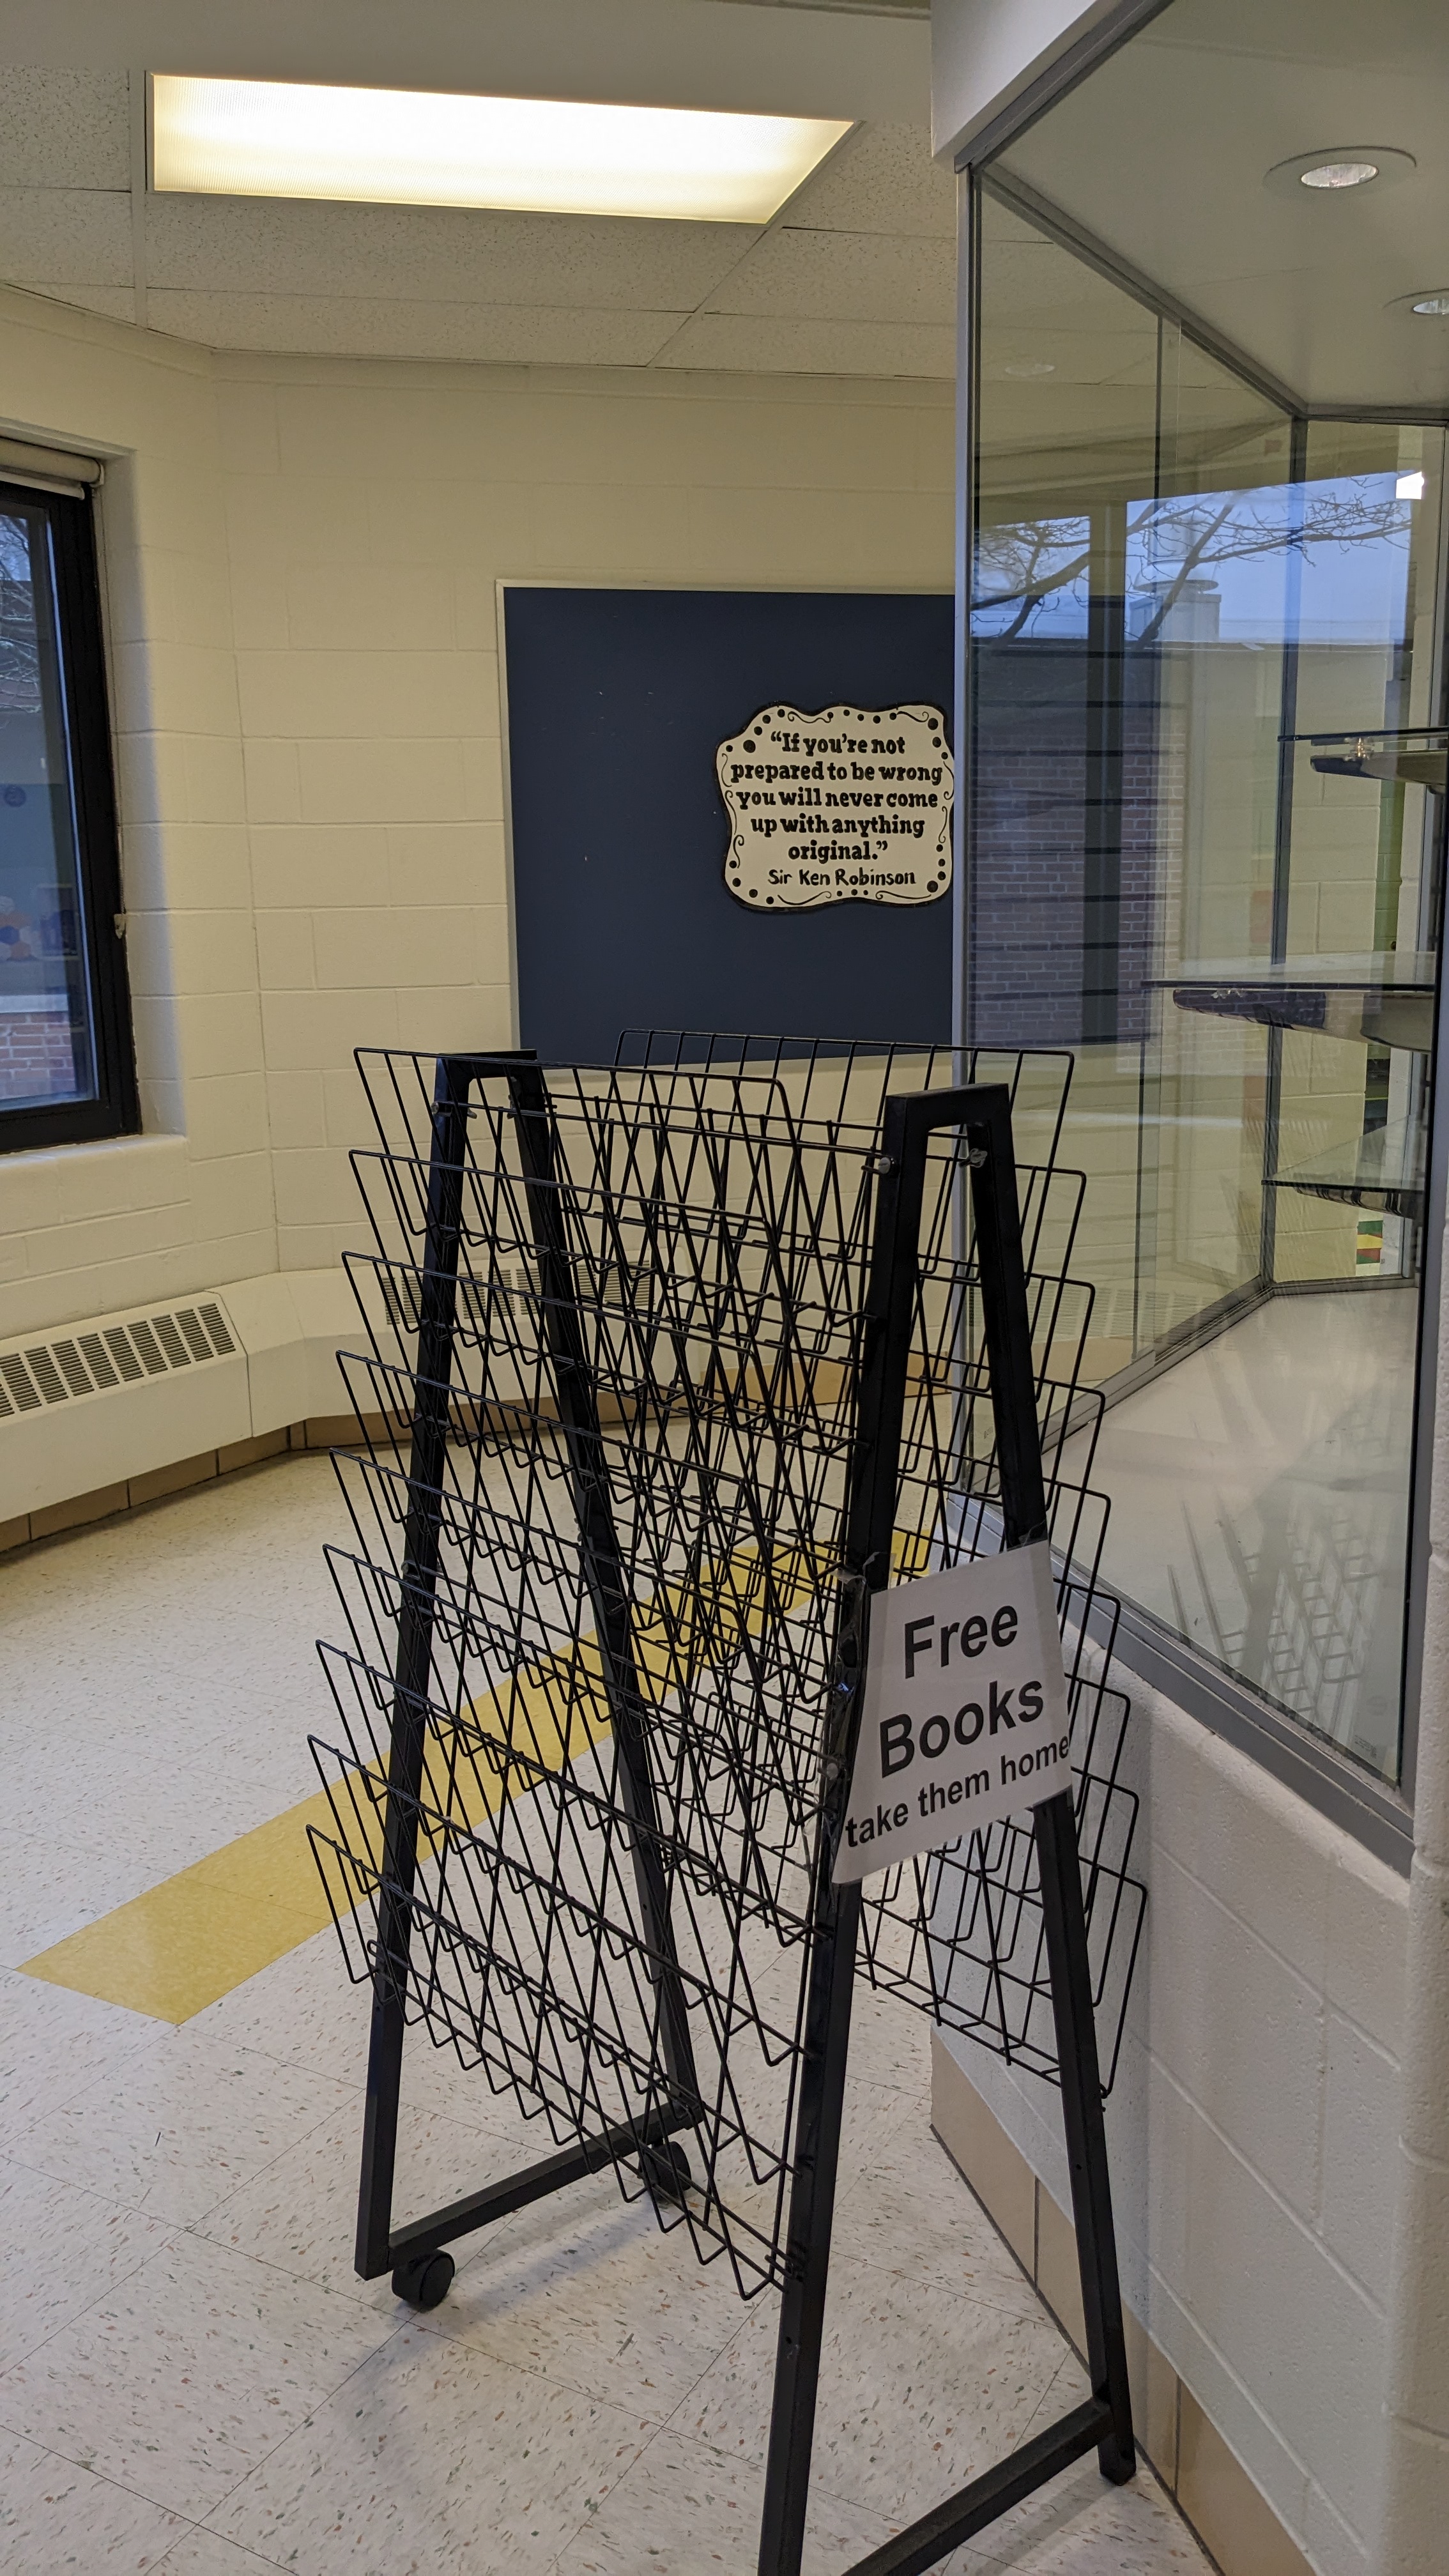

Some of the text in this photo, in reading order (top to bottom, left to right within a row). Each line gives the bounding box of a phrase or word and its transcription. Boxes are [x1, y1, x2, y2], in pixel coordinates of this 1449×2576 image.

[770, 731, 905, 756] “If you’re not
[730, 762, 942, 785] prepared to be wrong
[736, 787, 938, 809] you will never come
[751, 813, 925, 838] up with anything
[788, 839, 887, 864] original.”
[768, 868, 916, 886] Sir Ken Robinson
[904, 1605, 1018, 1679] Free
[879, 1680, 1043, 1779] Books
[845, 1736, 1069, 1848] take them home
